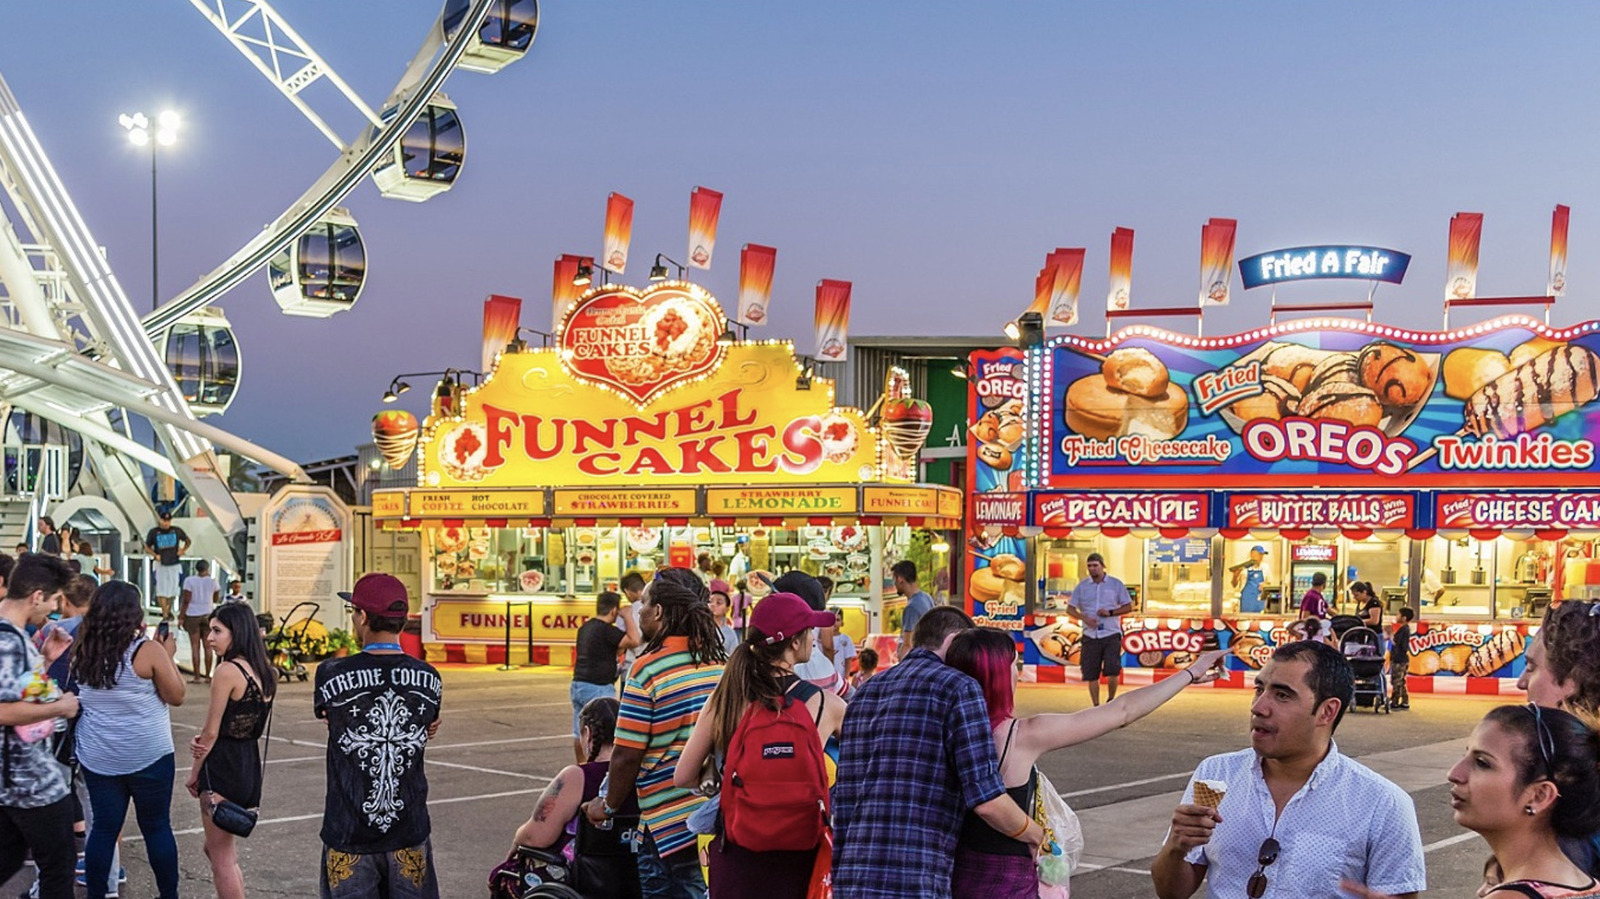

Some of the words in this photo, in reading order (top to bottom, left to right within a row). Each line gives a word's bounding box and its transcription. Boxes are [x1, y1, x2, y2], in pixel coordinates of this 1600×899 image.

[1261, 251, 1316, 279] Fried
[1322, 251, 1339, 273] A
[1345, 250, 1389, 274] Fair
[574, 327, 651, 343] FUNNEL
[574, 342, 651, 358] CAKES
[982, 362, 1012, 375] Fried
[1198, 364, 1257, 399] Fried
[482, 387, 757, 468] FUNNEL
[577, 416, 824, 475] CAKES
[1063, 436, 1115, 464] Fried
[1119, 436, 1230, 462] Cheesecake
[1247, 421, 1412, 475] OREOS
[1437, 436, 1591, 465] Twinkies
[472, 494, 490, 502] HOT
[571, 500, 680, 510] STRAWBERRIES
[723, 497, 842, 509] LEMONADE
[740, 490, 823, 498] STRAWBERRY
[871, 498, 911, 508] FUNNEL
[422, 502, 464, 511] COFFEE
[471, 502, 529, 511] CHOCOLATE
[976, 500, 1022, 521] LEMONADE
[1041, 498, 1065, 515] Fried
[1068, 500, 1151, 521] PECAN
[1160, 500, 1198, 521] PIE
[1234, 500, 1259, 516] Fried
[1261, 500, 1323, 522] BUTTER
[1329, 500, 1380, 522] BALLS
[1443, 499, 1469, 515] Fried
[1475, 500, 1554, 522] CHEESE
[985, 602, 1017, 618] Fried
[1125, 631, 1203, 653] OREOS
[1409, 630, 1483, 653] Twinkies
[319, 668, 385, 702] XTREME
